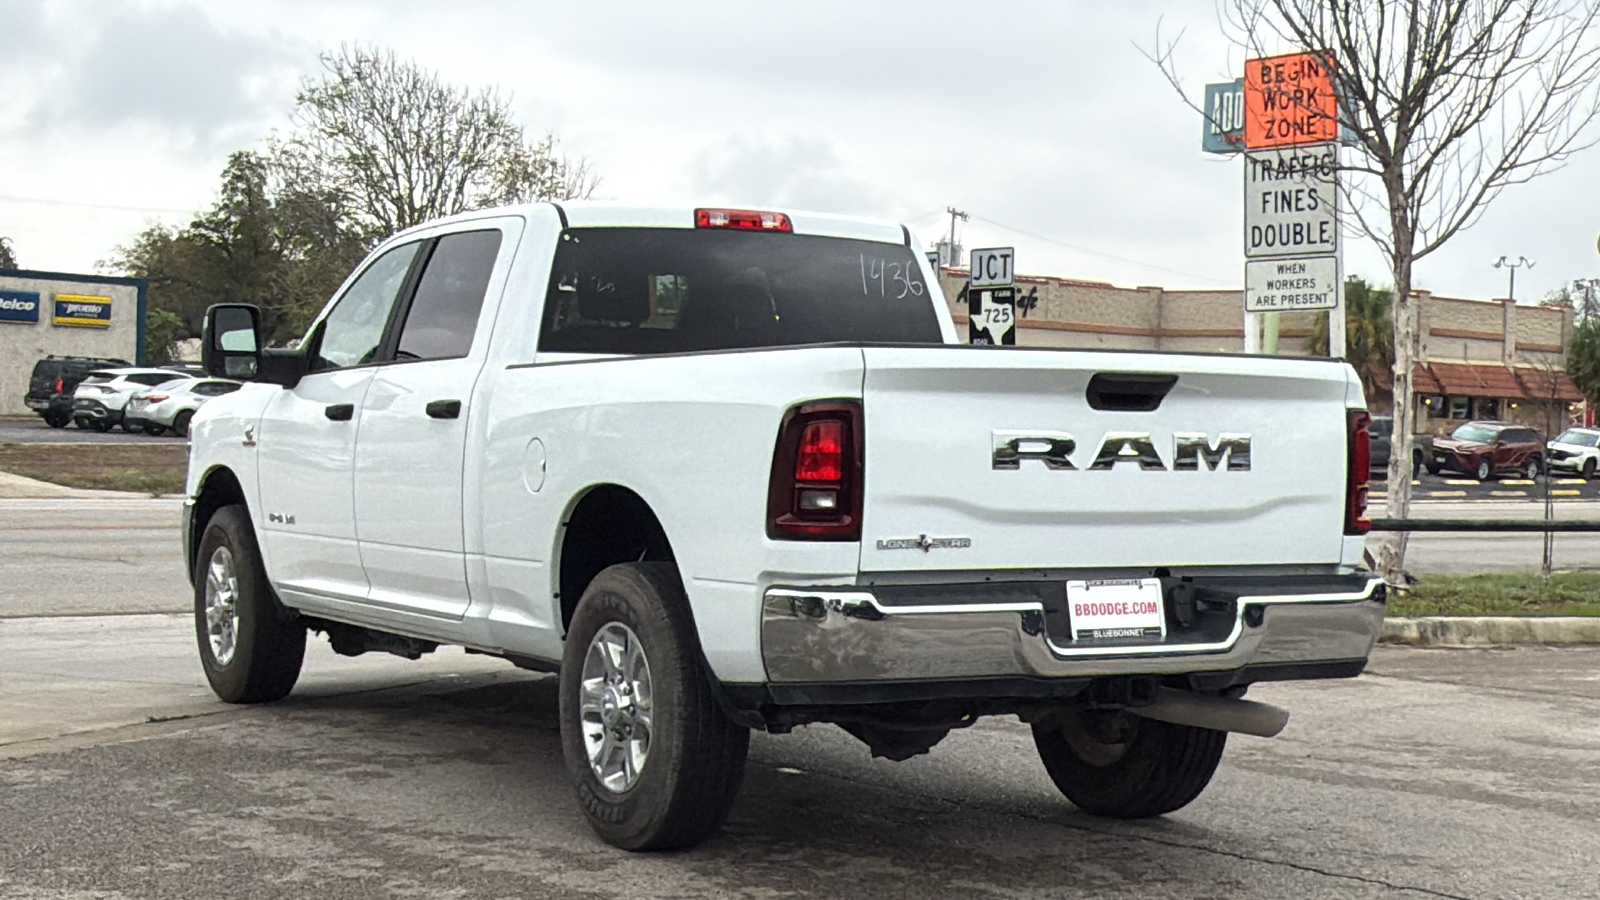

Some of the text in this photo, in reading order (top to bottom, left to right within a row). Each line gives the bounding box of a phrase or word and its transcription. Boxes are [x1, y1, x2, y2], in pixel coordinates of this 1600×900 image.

[1261, 62, 1319, 84] BEGIN
[1263, 86, 1319, 110] WORK
[1264, 115, 1318, 139] ZONE
[1251, 153, 1332, 182] TRAFFIC
[1262, 188, 1319, 214] FINES
[1251, 221, 1331, 248] DOUBLE
[859, 253, 923, 299] 1436
[973, 254, 1011, 281] JCT
[1276, 264, 1306, 275] WHEN
[1266, 279, 1317, 291] WORKERS
[1256, 293, 1329, 306] ARE PRESENT
[984, 307, 1010, 323] 725
[991, 429, 1252, 471] RAM
[1075, 602, 1158, 616] BBDODGE.COM
[1093, 628, 1145, 638] BLUEBONNET
